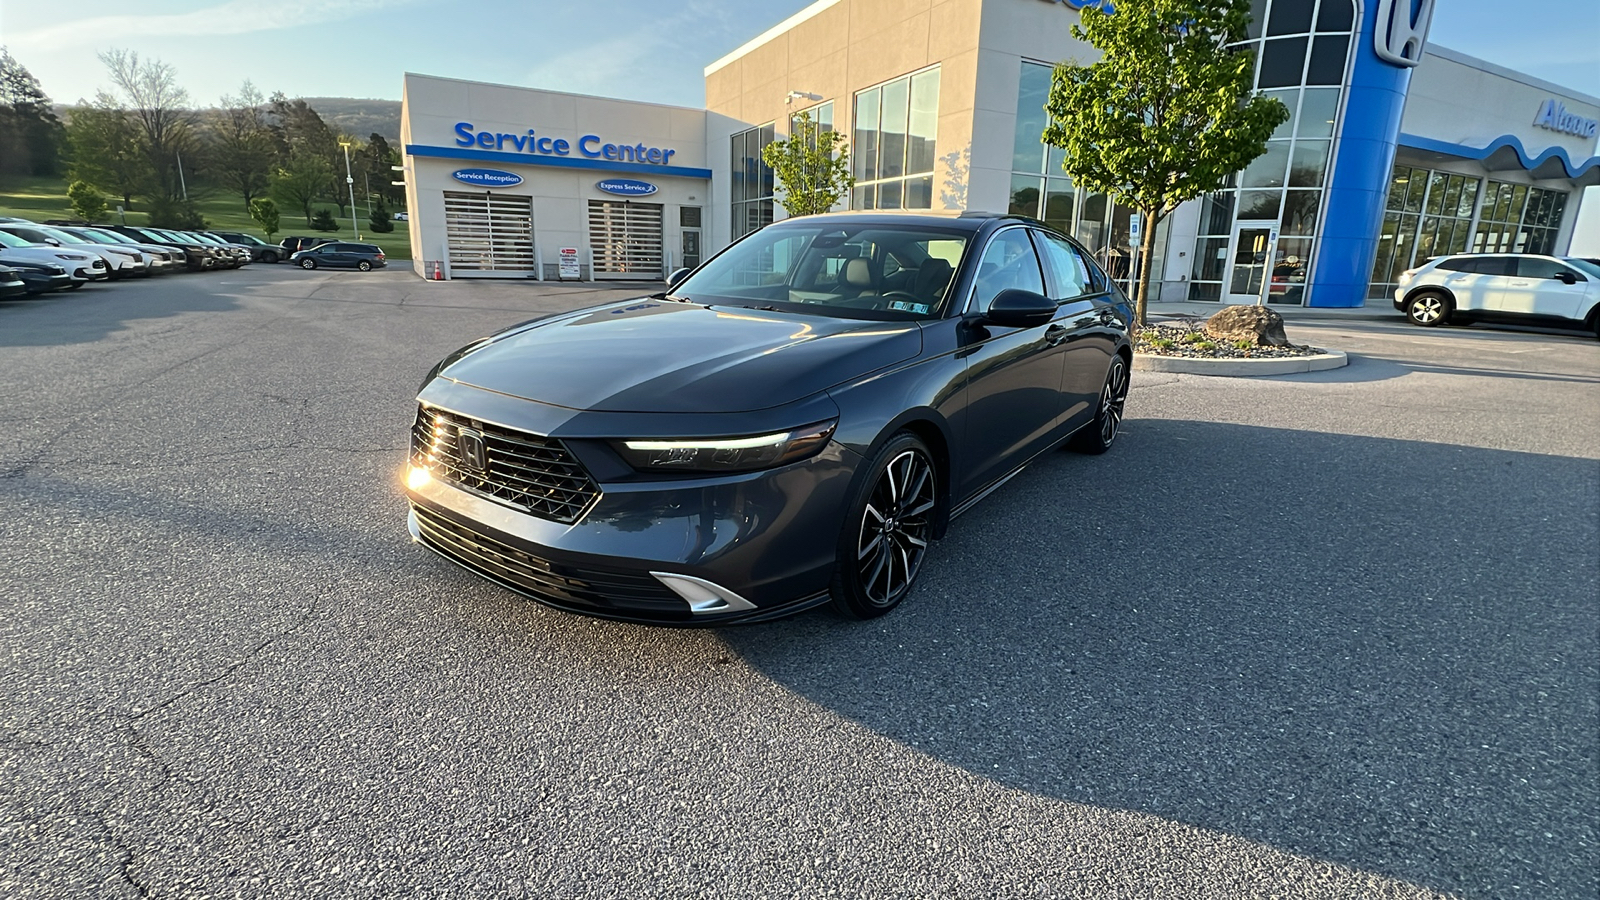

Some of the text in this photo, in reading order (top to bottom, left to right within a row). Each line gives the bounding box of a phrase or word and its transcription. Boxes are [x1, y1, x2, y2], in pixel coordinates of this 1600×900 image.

[454, 122, 676, 164] Service Center
[456, 171, 519, 182] Service Reception
[600, 182, 623, 190] Express
